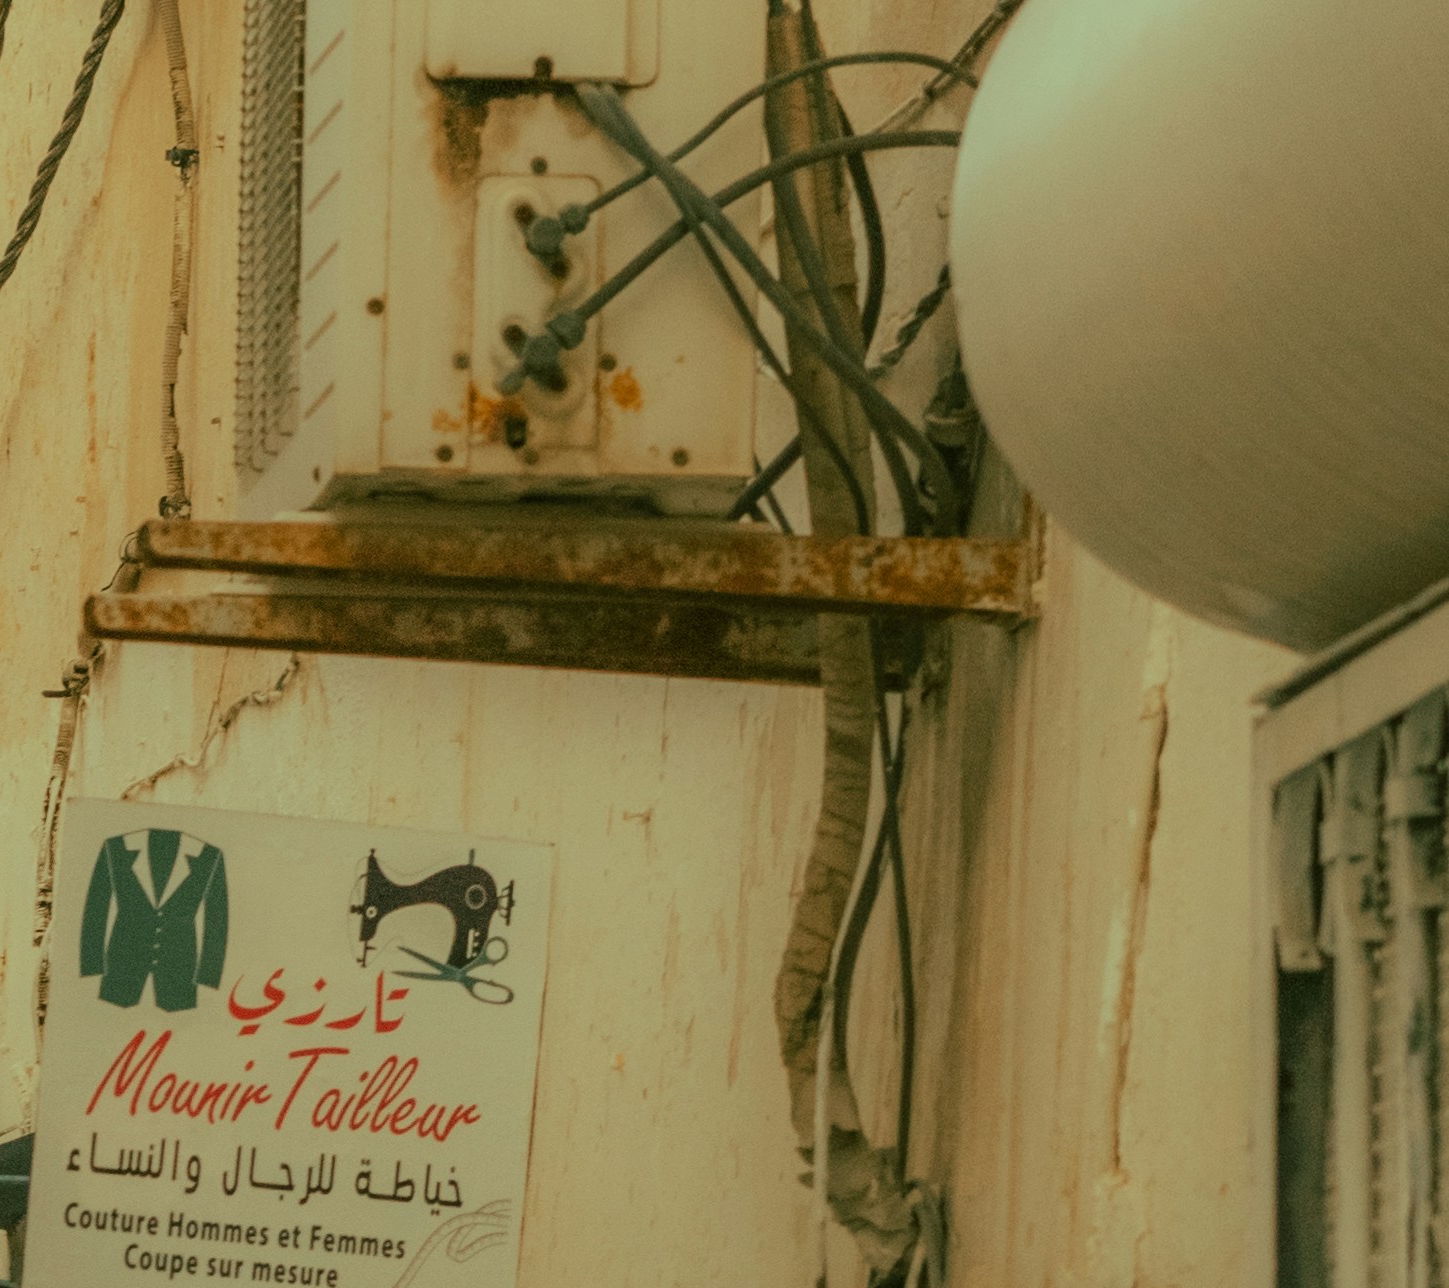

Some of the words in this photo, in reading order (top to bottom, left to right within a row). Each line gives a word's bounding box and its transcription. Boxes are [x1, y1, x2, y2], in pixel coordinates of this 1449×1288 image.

[228, 967, 410, 1037] تارزي
[84, 1029, 273, 1124] Mounir
[274, 1046, 481, 1142] Tailleur
[65, 1131, 202, 1195] والنساء
[221, 1145, 337, 1205] للرجال
[353, 1157, 463, 1215] خياطة
[63, 1202, 159, 1237] Couture
[168, 1212, 269, 1246] Hommes
[277, 1228, 303, 1250] et
[309, 1226, 407, 1260] Femmes
[123, 1243, 200, 1279] Coupe
[206, 1257, 244, 1279] sur
[252, 1264, 340, 1288] mesure
